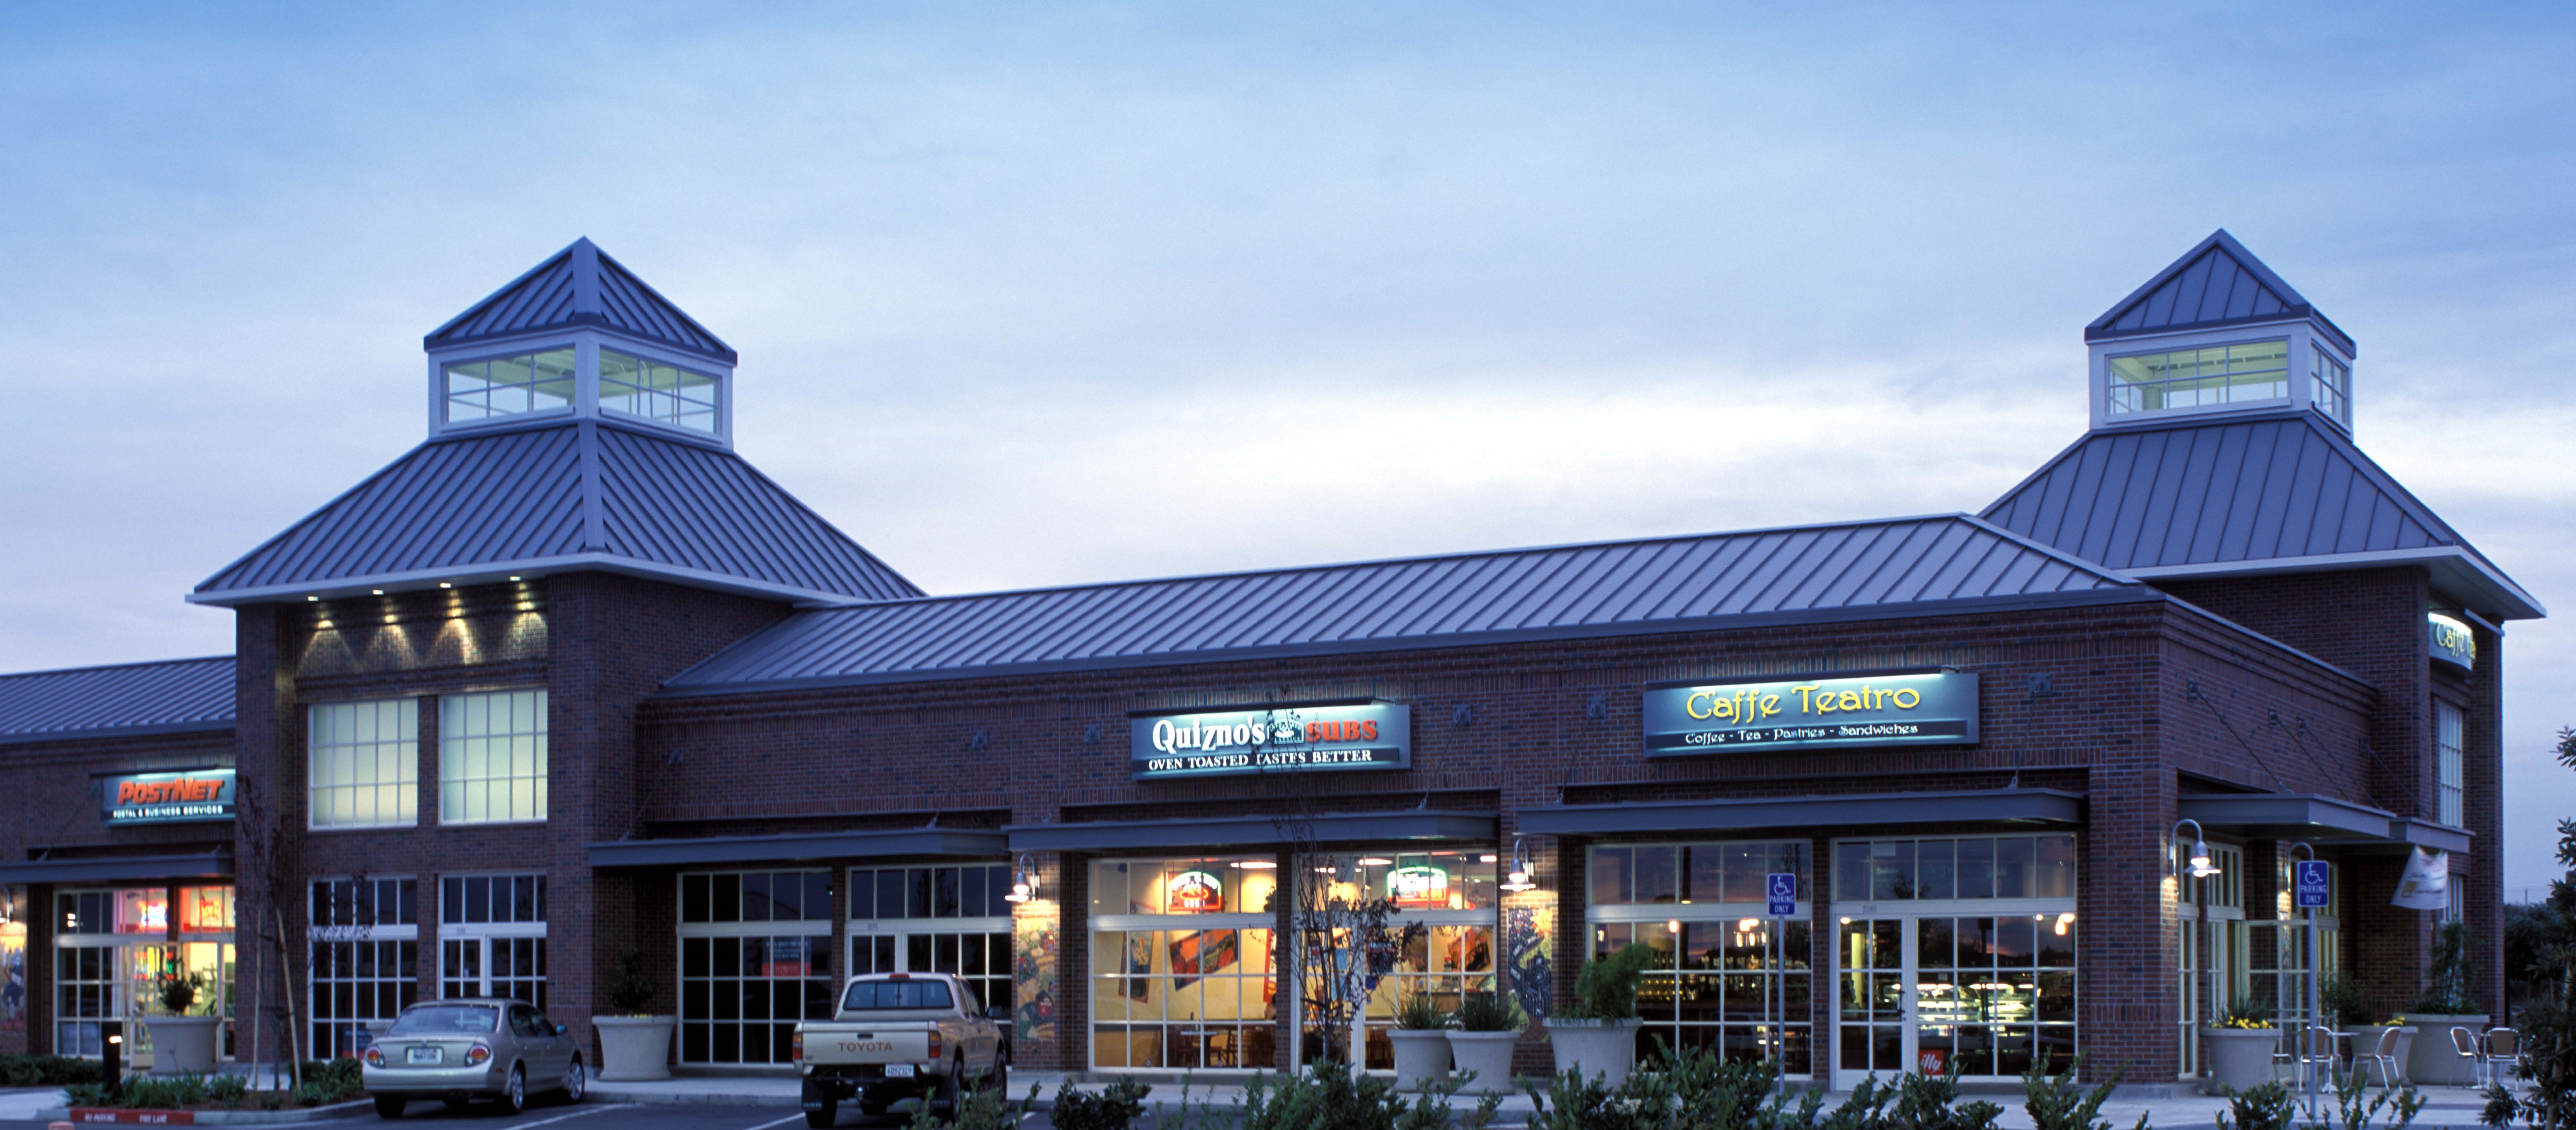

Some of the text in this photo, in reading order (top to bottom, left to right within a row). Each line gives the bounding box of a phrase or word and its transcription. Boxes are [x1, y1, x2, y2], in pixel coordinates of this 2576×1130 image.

[1687, 683, 1921, 724] Caffe Teatro
[1152, 716, 1266, 755] Quizno's
[1685, 724, 1918, 746] Coffee Tea Pastries Sandwiches
[1149, 749, 1372, 771] OVEN TOASTED TASTES BETTER
[113, 808, 136, 819] POSTAL
[145, 806, 181, 817] BUSINESS
[183, 805, 223, 815] SERVICES
[2300, 884, 2327, 893] PARKING
[1769, 895, 1794, 904] PARKING
[2305, 894, 2321, 904] ONLY
[1775, 905, 1789, 913] ONLY
[837, 1041, 893, 1053] TOYOTA
[1921, 1053, 1941, 1074] illy
